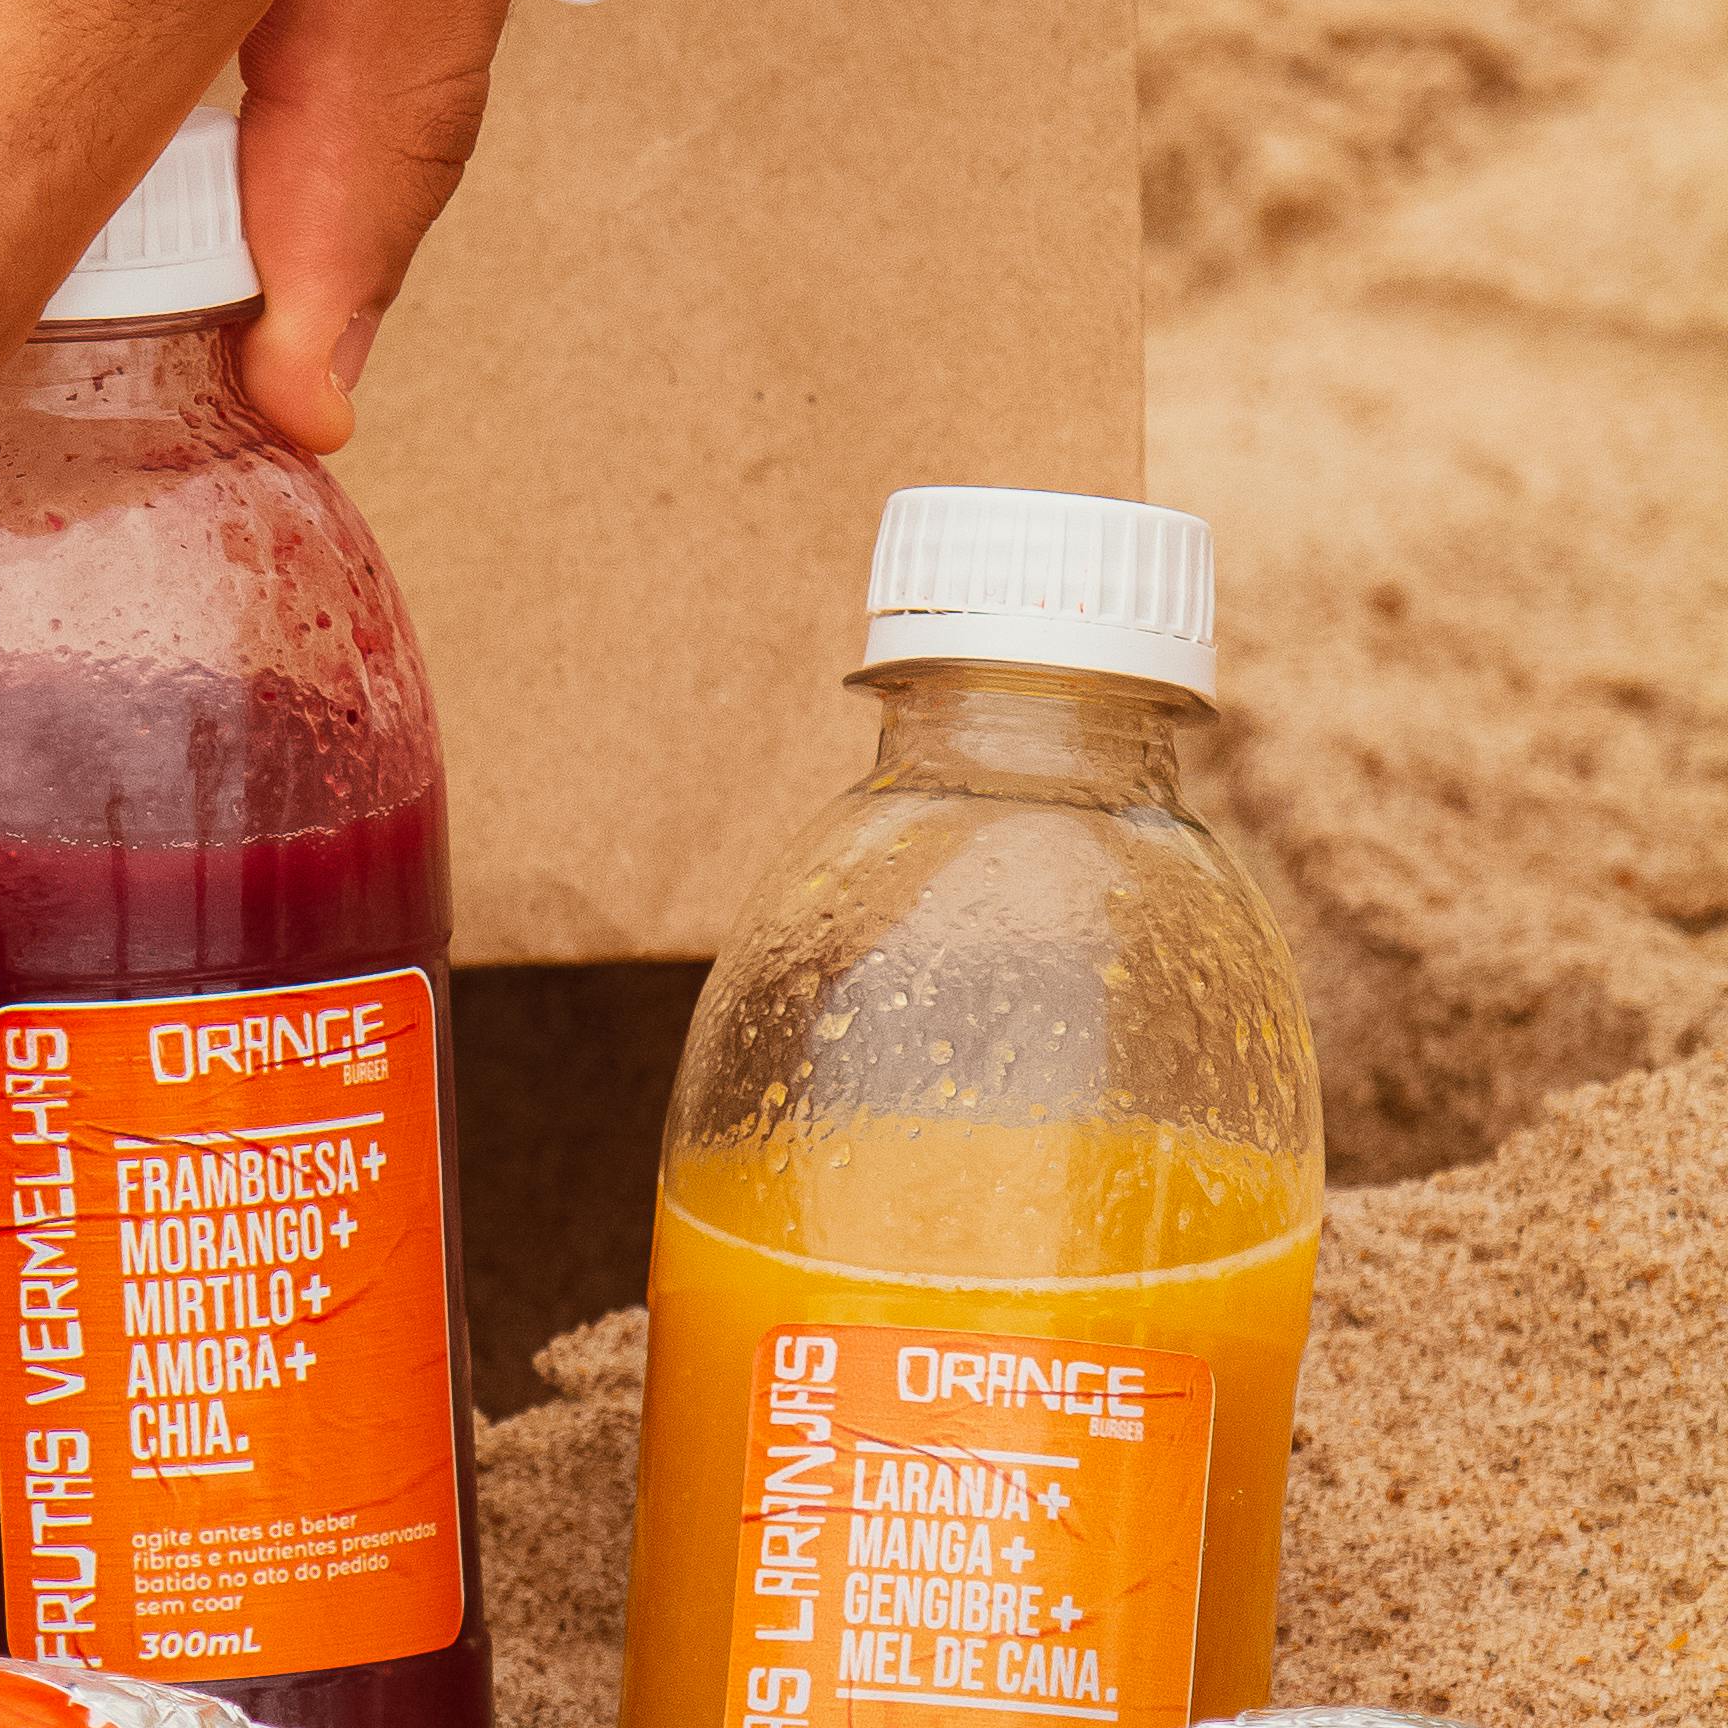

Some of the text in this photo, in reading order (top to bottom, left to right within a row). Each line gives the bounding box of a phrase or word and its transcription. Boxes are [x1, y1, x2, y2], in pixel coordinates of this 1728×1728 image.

[148, 1003, 387, 1085] ORANGE
[342, 1058, 390, 1086] BURGER
[5, 1027, 103, 1669] FRUTAS VERMELHAS
[897, 1346, 1146, 1419] ORANGE
[129, 1399, 249, 1460] CHIA.
[1088, 1416, 1145, 1443] BURGER
[754, 1334, 838, 1642] LARANJAS
[131, 1514, 358, 1553] agite antes de beber
[132, 1521, 437, 1571] fibras e nutrientes preservados
[134, 1552, 390, 1594] batido no ato do pedido
[134, 1593, 244, 1617] sem coar
[138, 1627, 262, 1660] 300mL
[838, 1630, 1118, 1703] MEL DE CANA.
